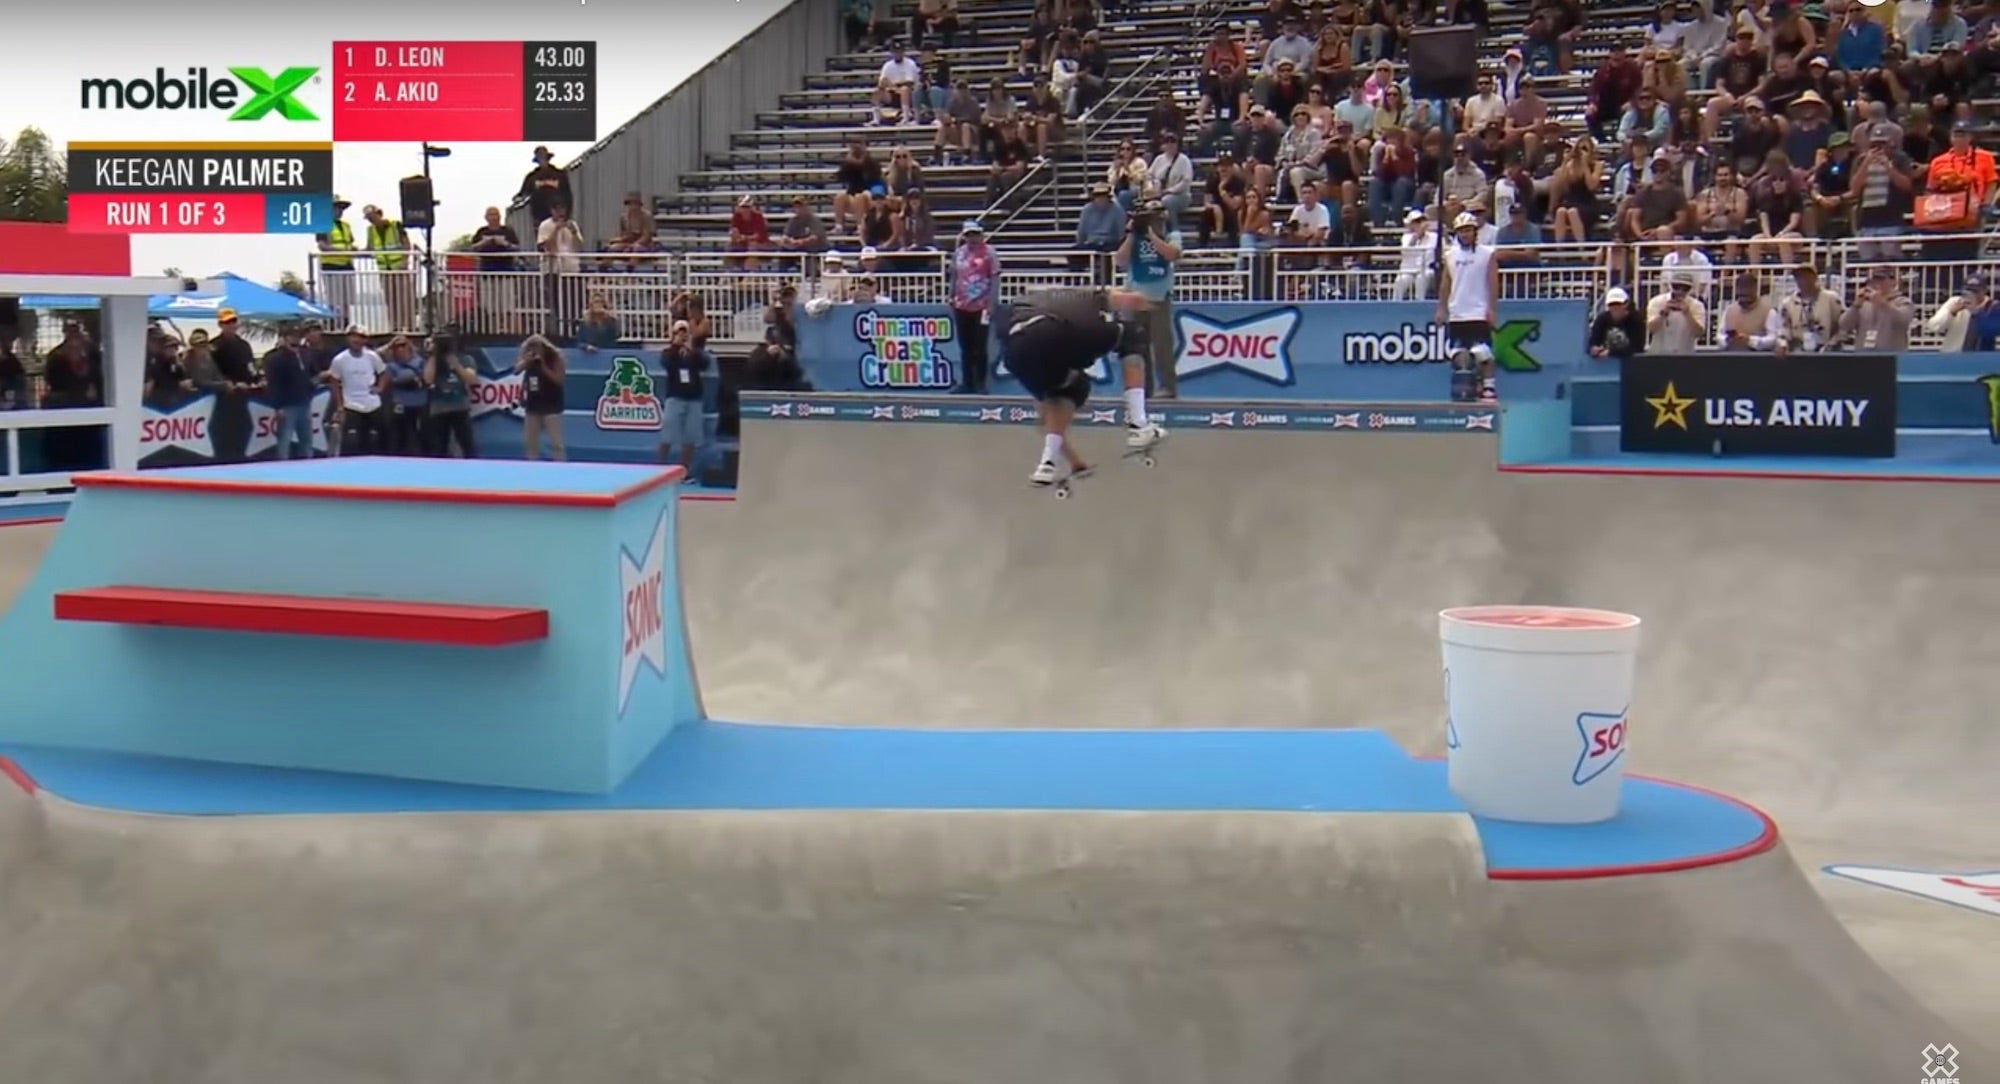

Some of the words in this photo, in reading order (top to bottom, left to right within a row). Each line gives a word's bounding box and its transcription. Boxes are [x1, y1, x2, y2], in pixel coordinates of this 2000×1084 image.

[857, 311, 951, 339] Cinnamon
[872, 336, 933, 362] Toast
[1187, 333, 1279, 359] SONIC
[862, 354, 951, 386] Crunch
[468, 383, 525, 405] SONI
[603, 406, 655, 420] JARRITOS
[1705, 398, 1762, 425] U.S.
[1767, 399, 1869, 427] ARMY
[140, 416, 205, 442] SONIC
[626, 570, 661, 656] SONIC
